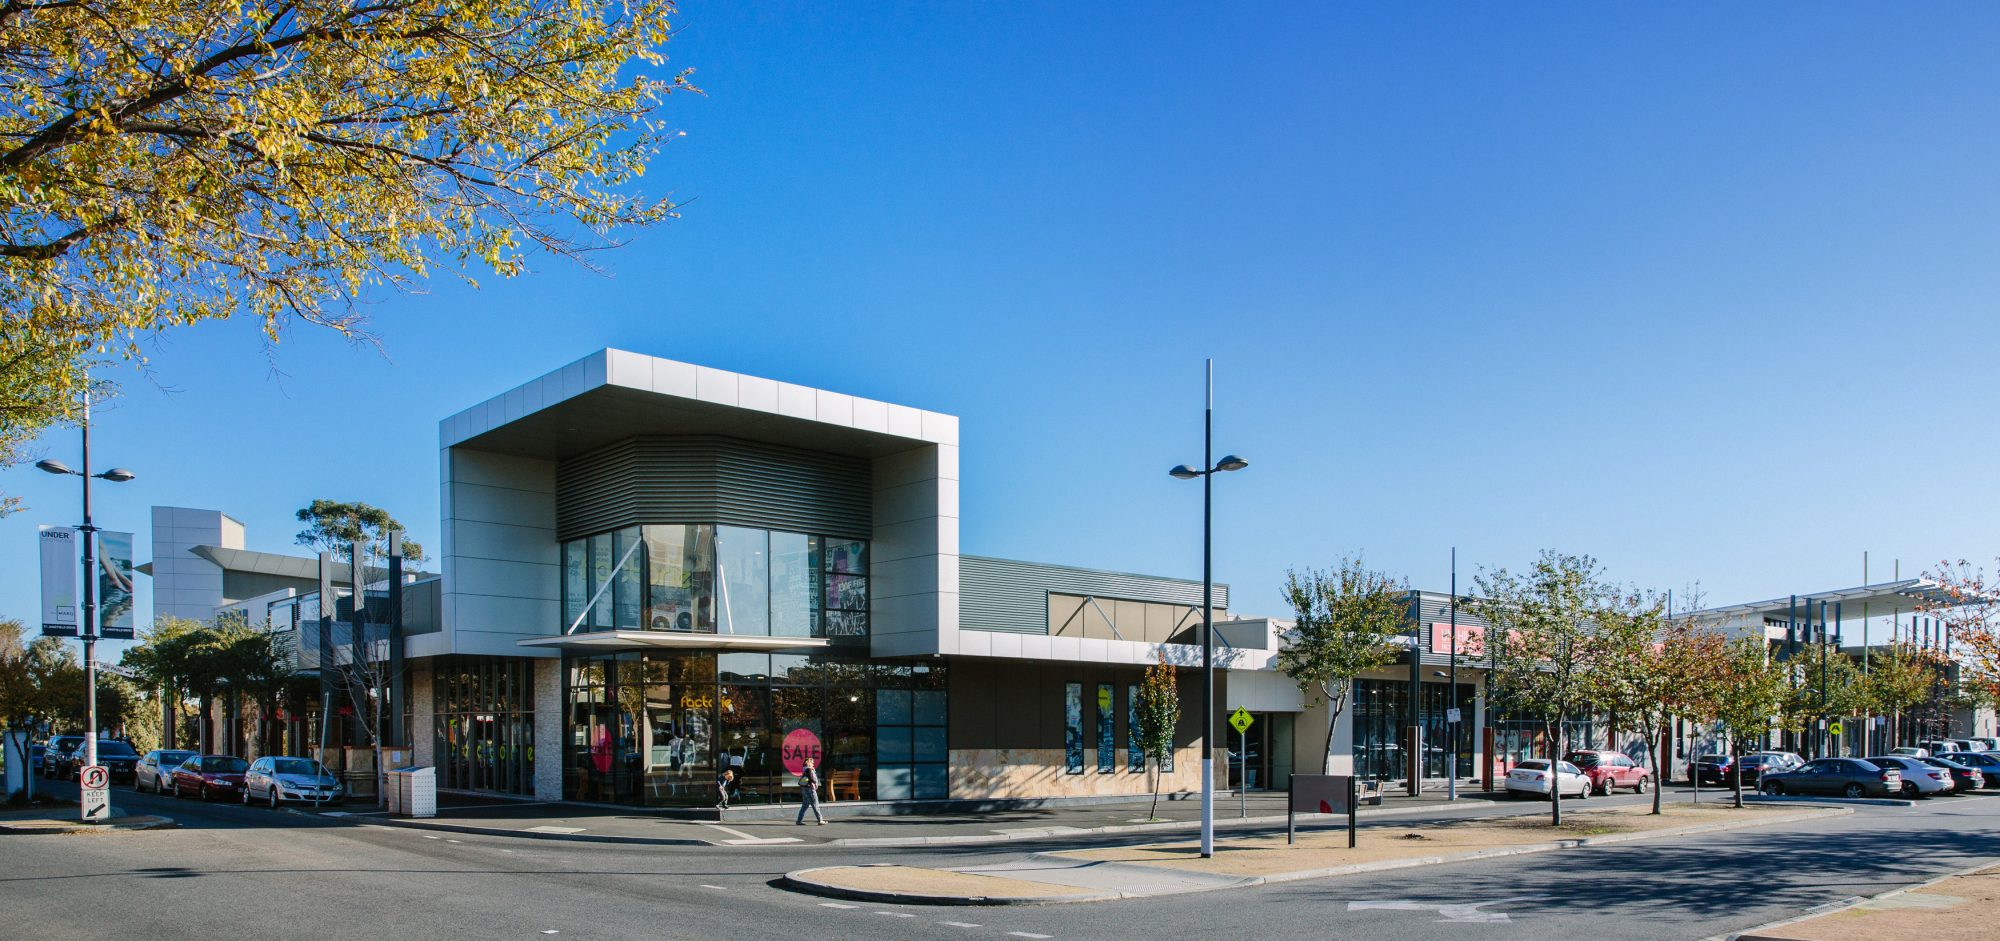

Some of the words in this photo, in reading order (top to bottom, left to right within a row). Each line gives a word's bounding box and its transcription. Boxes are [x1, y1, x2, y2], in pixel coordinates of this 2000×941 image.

[41, 531, 69, 539] UNDER
[680, 695, 732, 708] factoie
[783, 744, 820, 760] SALE
